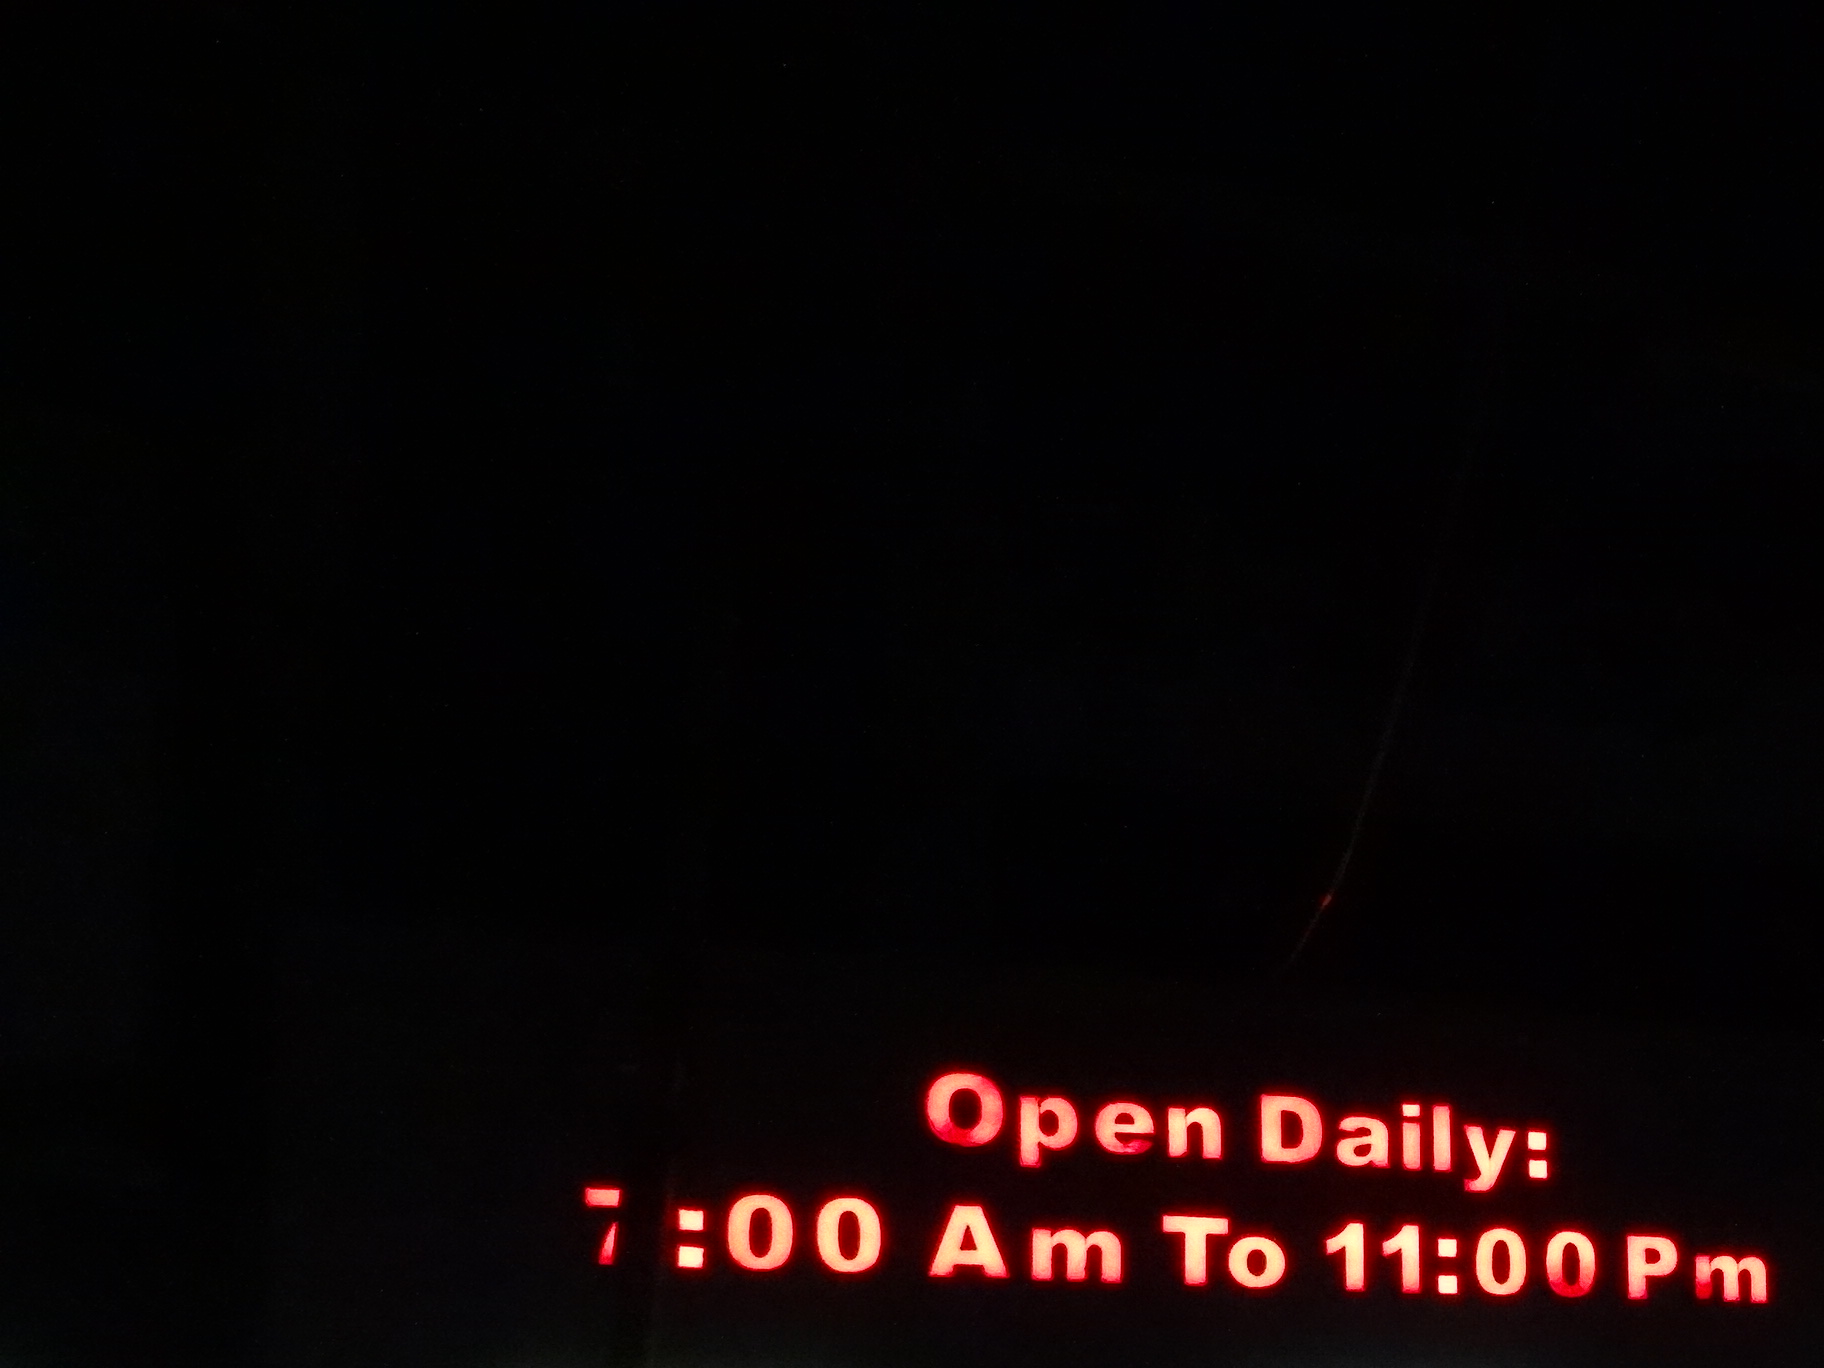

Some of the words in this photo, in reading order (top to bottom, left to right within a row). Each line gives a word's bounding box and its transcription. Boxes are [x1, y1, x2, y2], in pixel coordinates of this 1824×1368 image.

[925, 1071, 1223, 1168] Open
[1259, 1093, 1549, 1192] Daily:
[928, 1204, 1123, 1284] Am
[1161, 1214, 1287, 1289] To
[1325, 1221, 1598, 1298] 11:00
[1626, 1234, 1769, 1304] Pm
